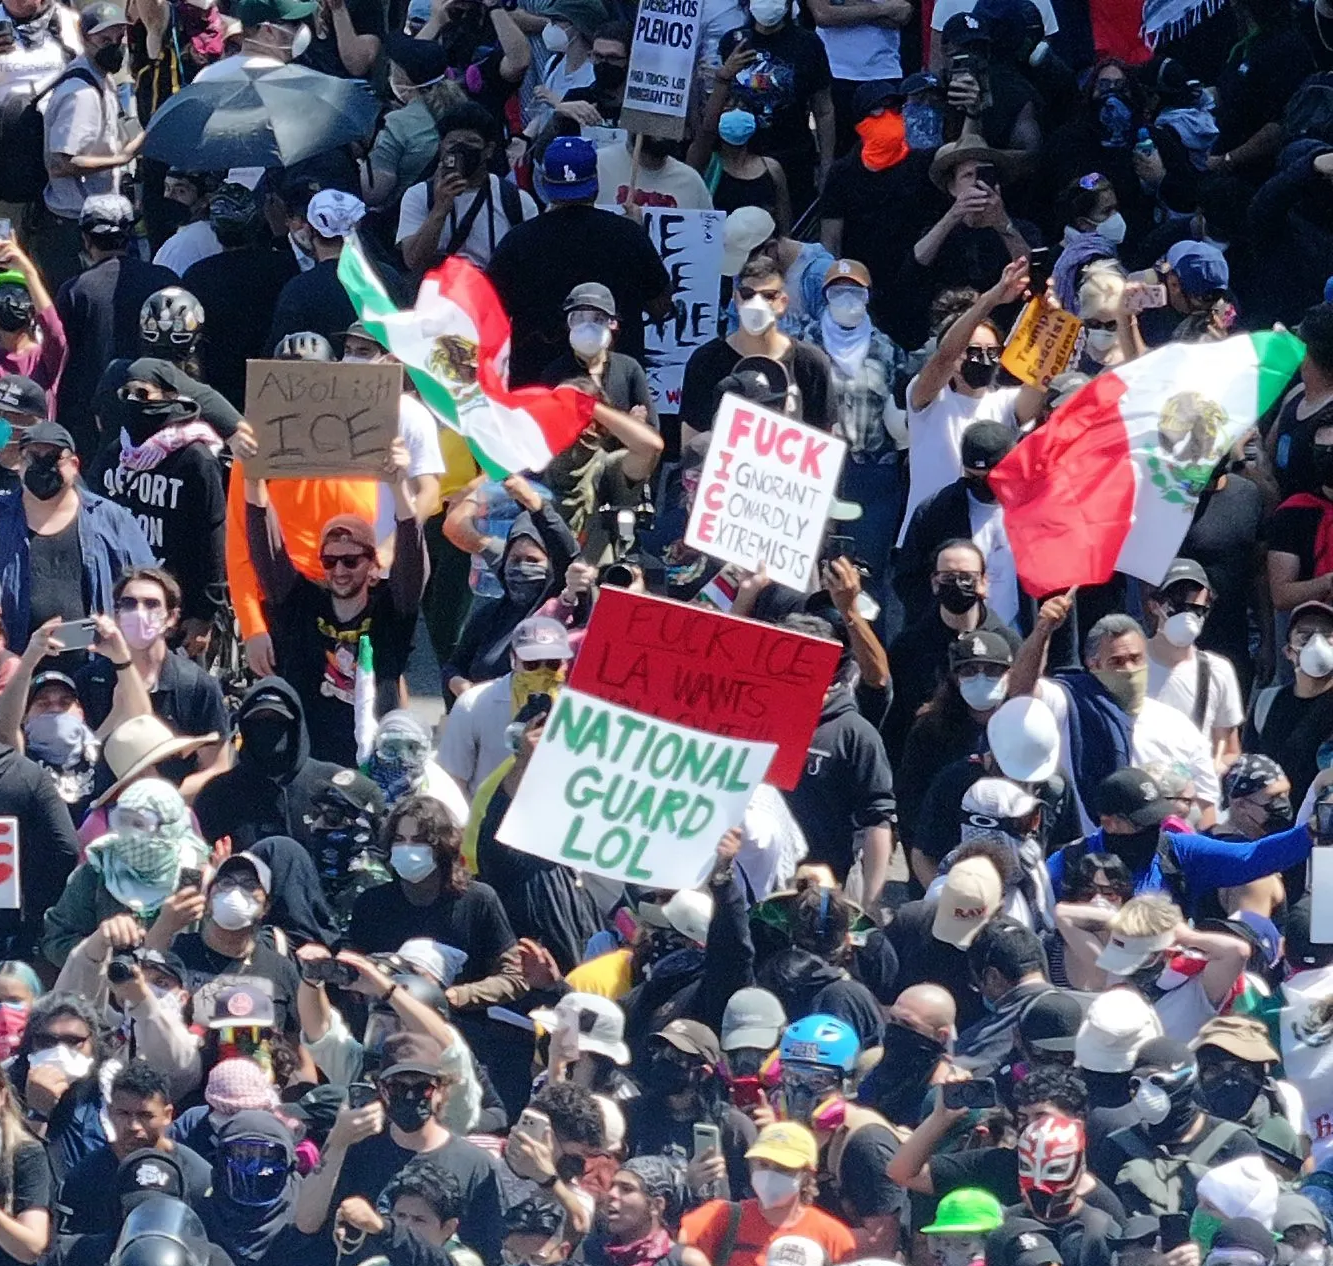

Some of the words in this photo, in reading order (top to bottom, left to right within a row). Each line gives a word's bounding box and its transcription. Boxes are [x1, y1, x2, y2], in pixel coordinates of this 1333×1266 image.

[636, 16, 694, 50] PLENOS
[266, 408, 387, 460] ICE
[728, 407, 830, 481] FUCK
[696, 512, 810, 580] EXTREMISTS
[704, 482, 810, 541] COWARDLY
[626, 602, 741, 661] FUCK
[751, 632, 821, 678] ICE
[597, 641, 650, 696] LA
[673, 665, 771, 719] WANTS
[546, 695, 752, 793] NATIONAL
[564, 765, 716, 841] GUARD
[560, 814, 653, 881] LOL
